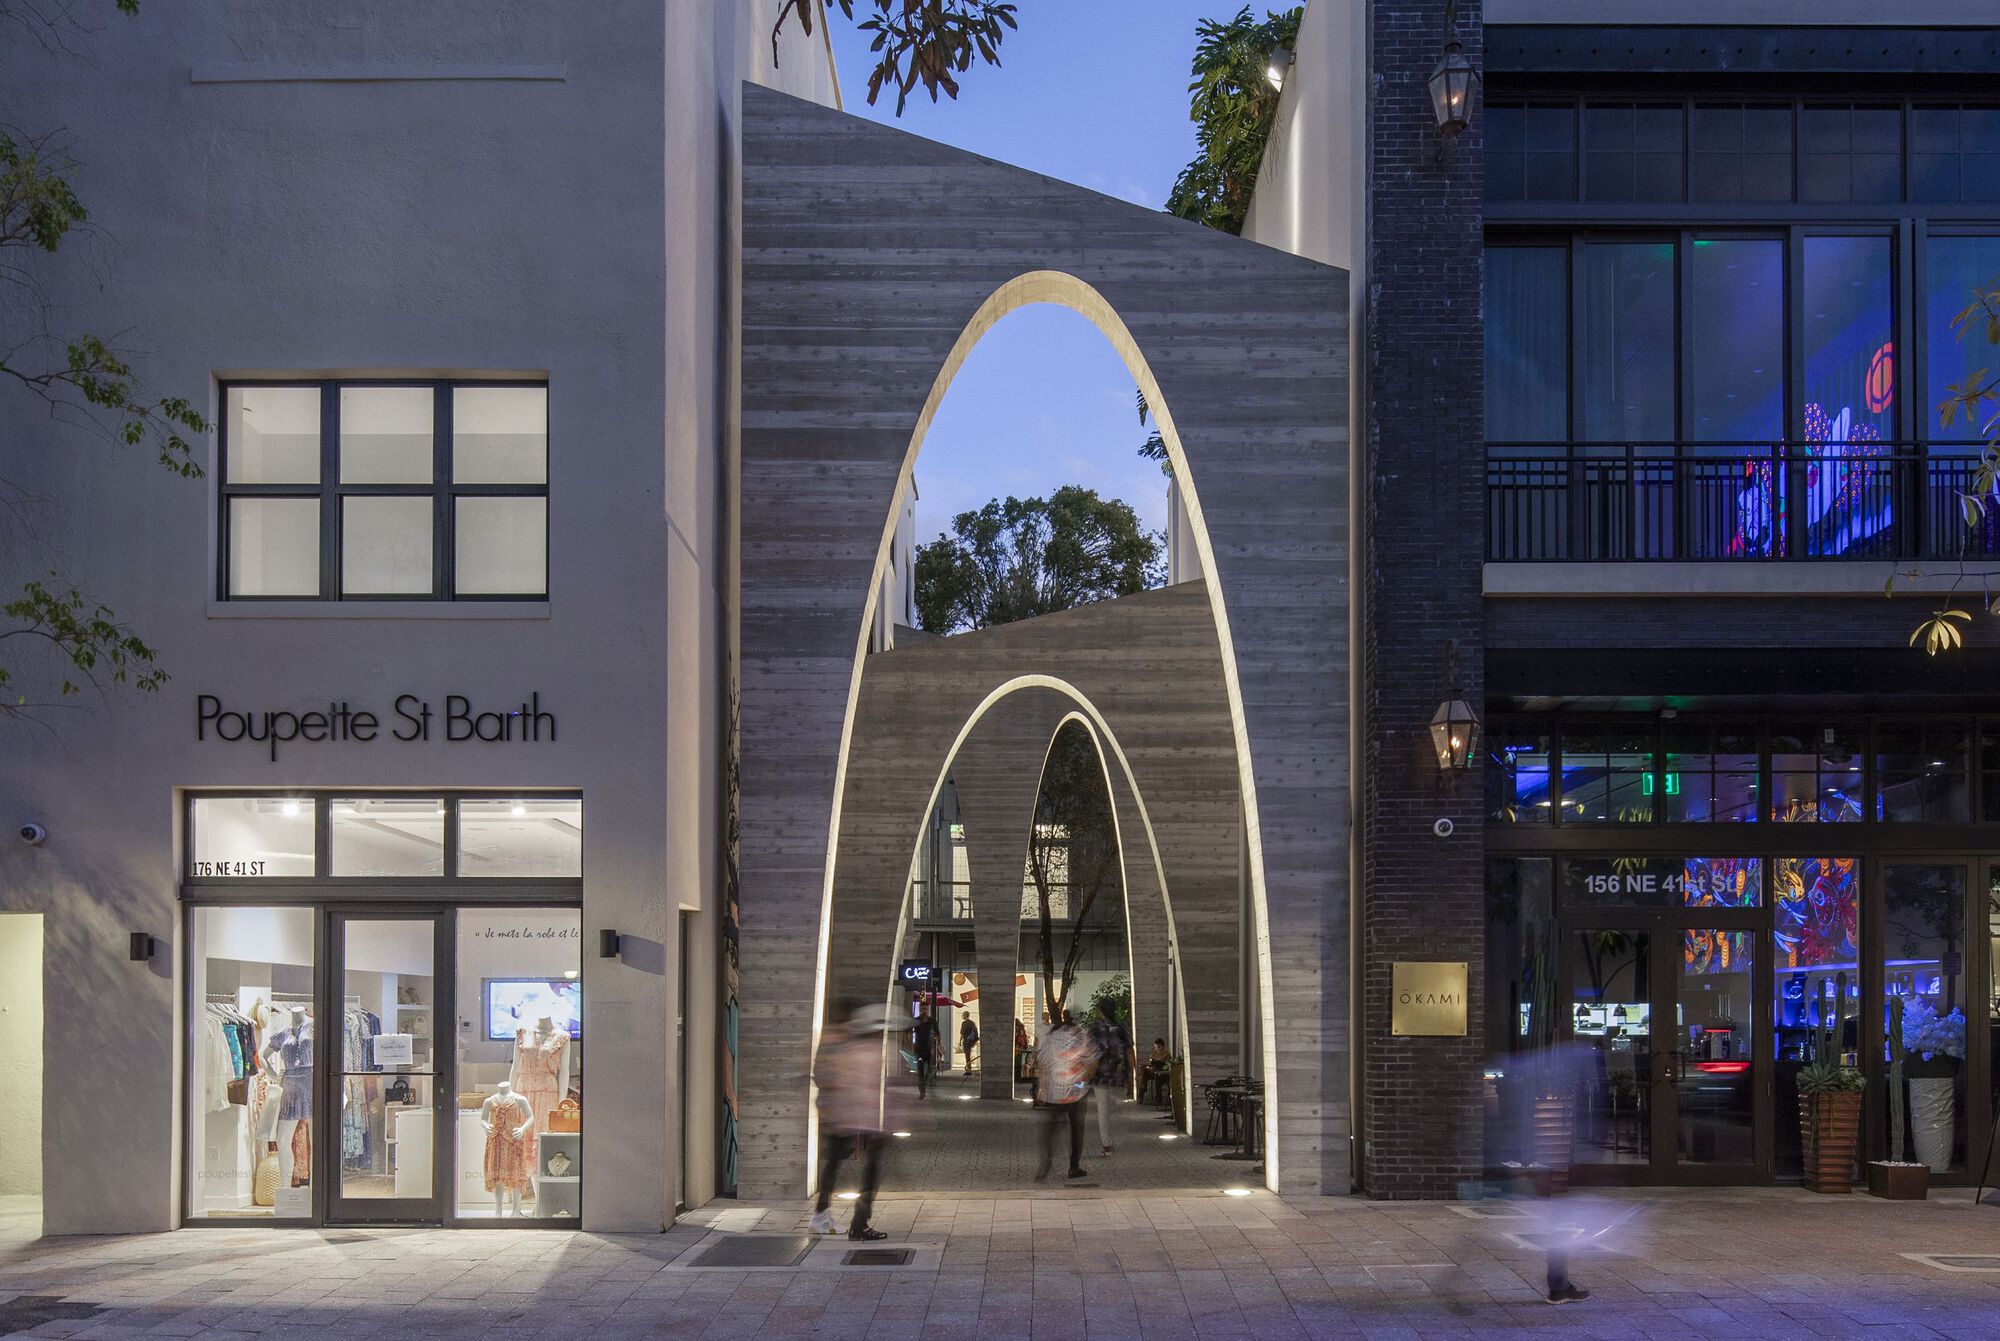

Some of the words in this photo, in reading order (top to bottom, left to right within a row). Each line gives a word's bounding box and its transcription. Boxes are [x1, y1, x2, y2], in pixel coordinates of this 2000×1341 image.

[198, 695, 378, 761] Poupette
[392, 694, 432, 741] St
[446, 691, 555, 741] Barth
[193, 861, 212, 876] 176
[215, 861, 231, 876] NE
[233, 861, 247, 876] 41
[250, 861, 266, 876] ST
[1584, 874, 1621, 894] 156
[1626, 874, 1656, 893] NE
[1661, 874, 1706, 893] 41st
[484, 927, 495, 938] Je
[498, 928, 519, 939] mets
[523, 927, 533, 938] la
[537, 927, 555, 939] robe
[559, 929, 568, 938] et
[1399, 988, 1460, 1005] ŌKAMI
